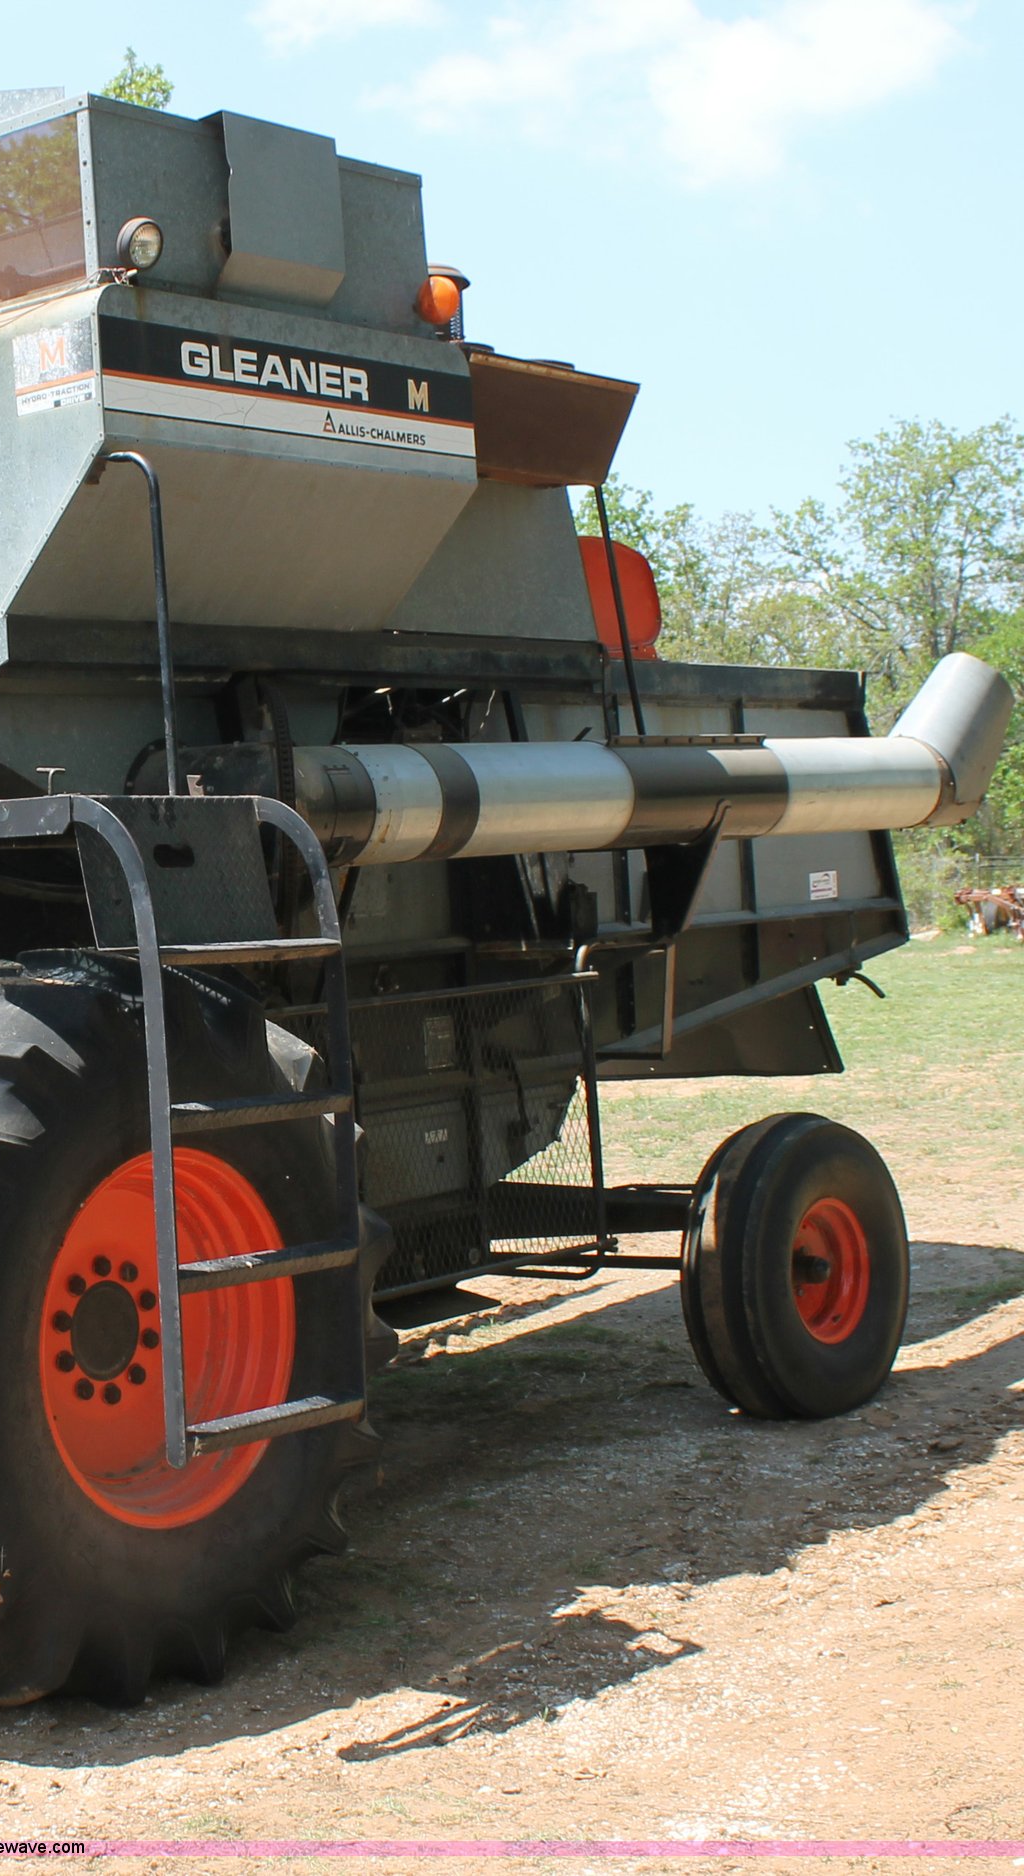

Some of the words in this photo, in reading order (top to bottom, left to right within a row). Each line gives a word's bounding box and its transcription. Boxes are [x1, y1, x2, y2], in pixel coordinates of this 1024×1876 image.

[39, 336, 65, 371] M
[180, 341, 369, 401] GLEANER
[407, 378, 430, 412] M
[338, 423, 426, 446] ALLIS-CHALMERS
